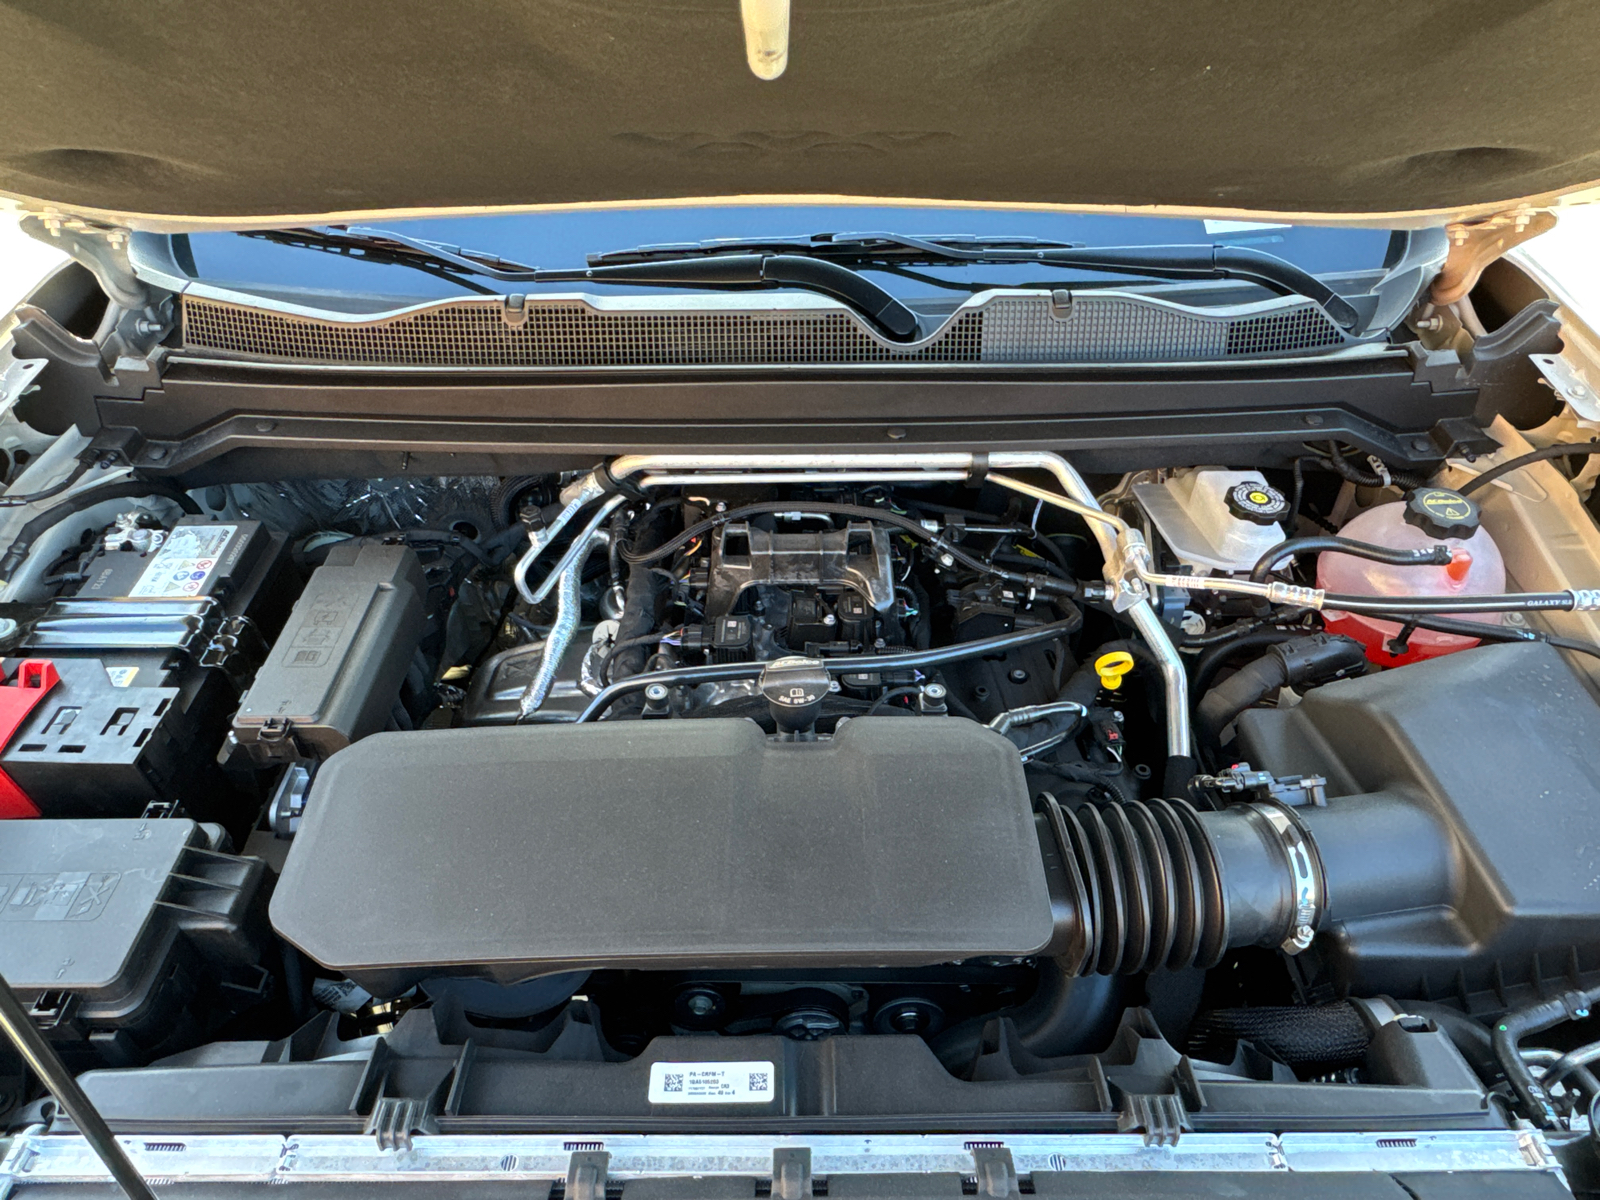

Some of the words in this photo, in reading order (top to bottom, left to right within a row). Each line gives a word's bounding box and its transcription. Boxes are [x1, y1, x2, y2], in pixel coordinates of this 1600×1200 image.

[1527, 599, 1562, 607] GALAXY
[768, 659, 820, 669] ACDelco
[778, 695, 792, 704] SAE
